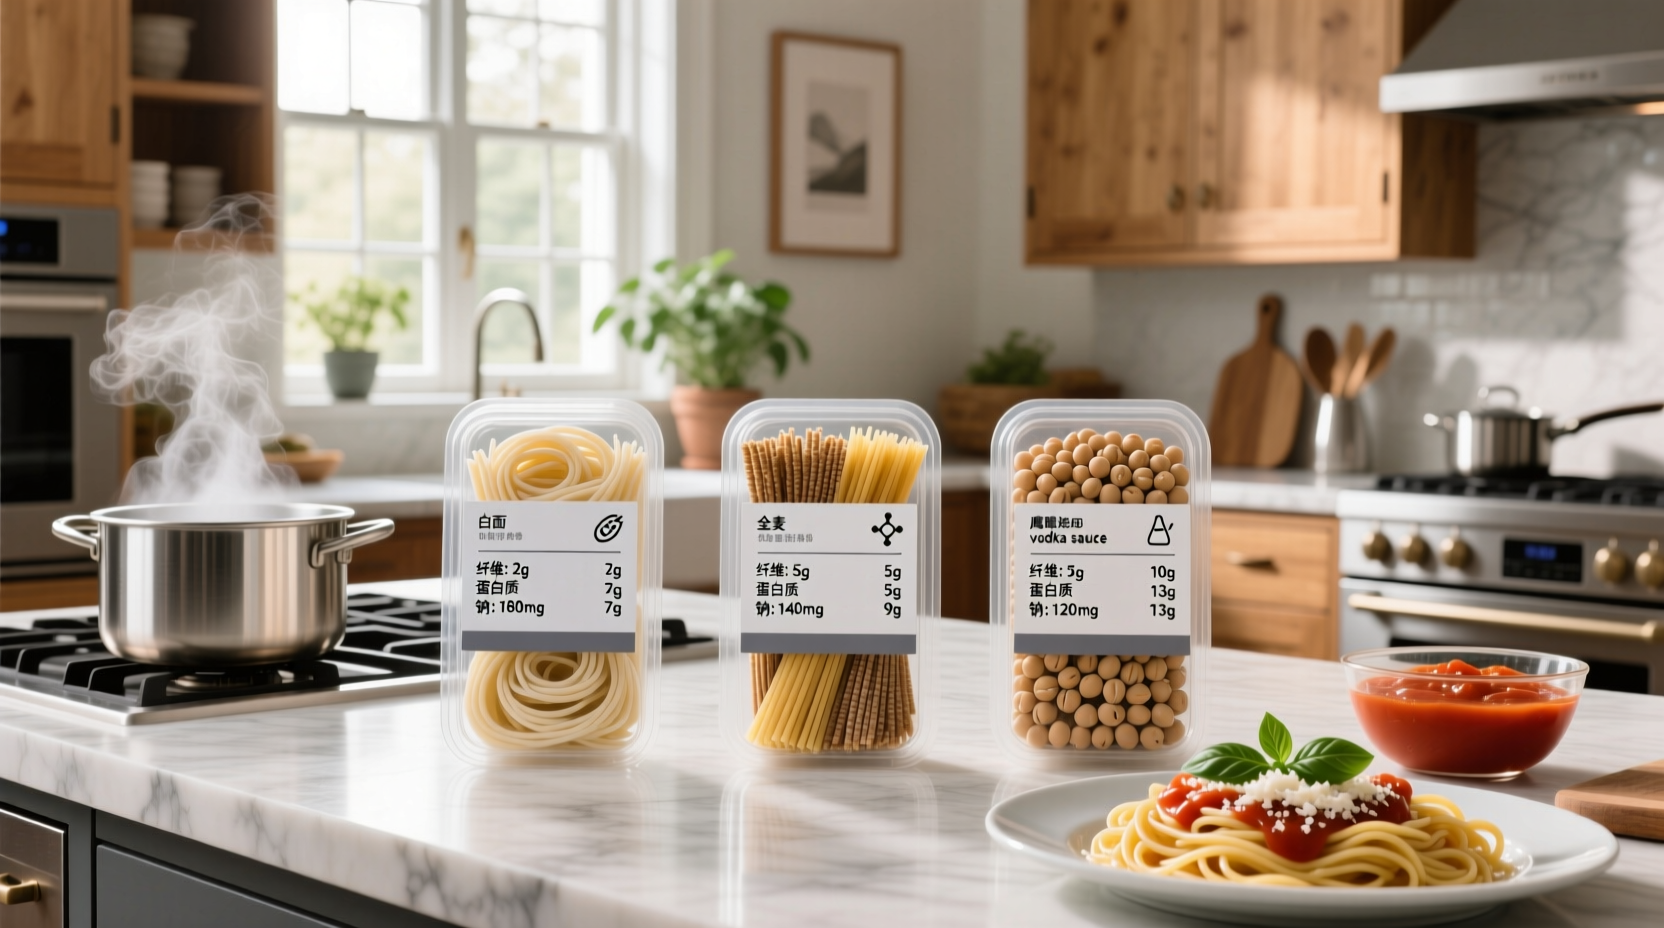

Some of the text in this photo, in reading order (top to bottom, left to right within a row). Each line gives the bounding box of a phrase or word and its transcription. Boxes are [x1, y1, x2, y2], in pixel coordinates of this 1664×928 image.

[478, 513, 507, 529] 白面
[757, 515, 786, 531] 全麦
[1030, 531, 1107, 544] vodka sauce
[476, 561, 622, 579] 纤维: 2g 2g
[756, 562, 902, 581] 纤维: 5g 5g
[1029, 563, 1175, 582] 纤维: 5g 10g
[605, 582, 622, 599] 7g
[884, 583, 902, 600] 5g
[1151, 585, 1176, 600] 13g
[604, 601, 622, 617] 7g
[778, 602, 824, 618] 140mg
[883, 602, 901, 619] 9g
[1052, 603, 1099, 619] 120mg
[1150, 603, 1176, 620] 13g
